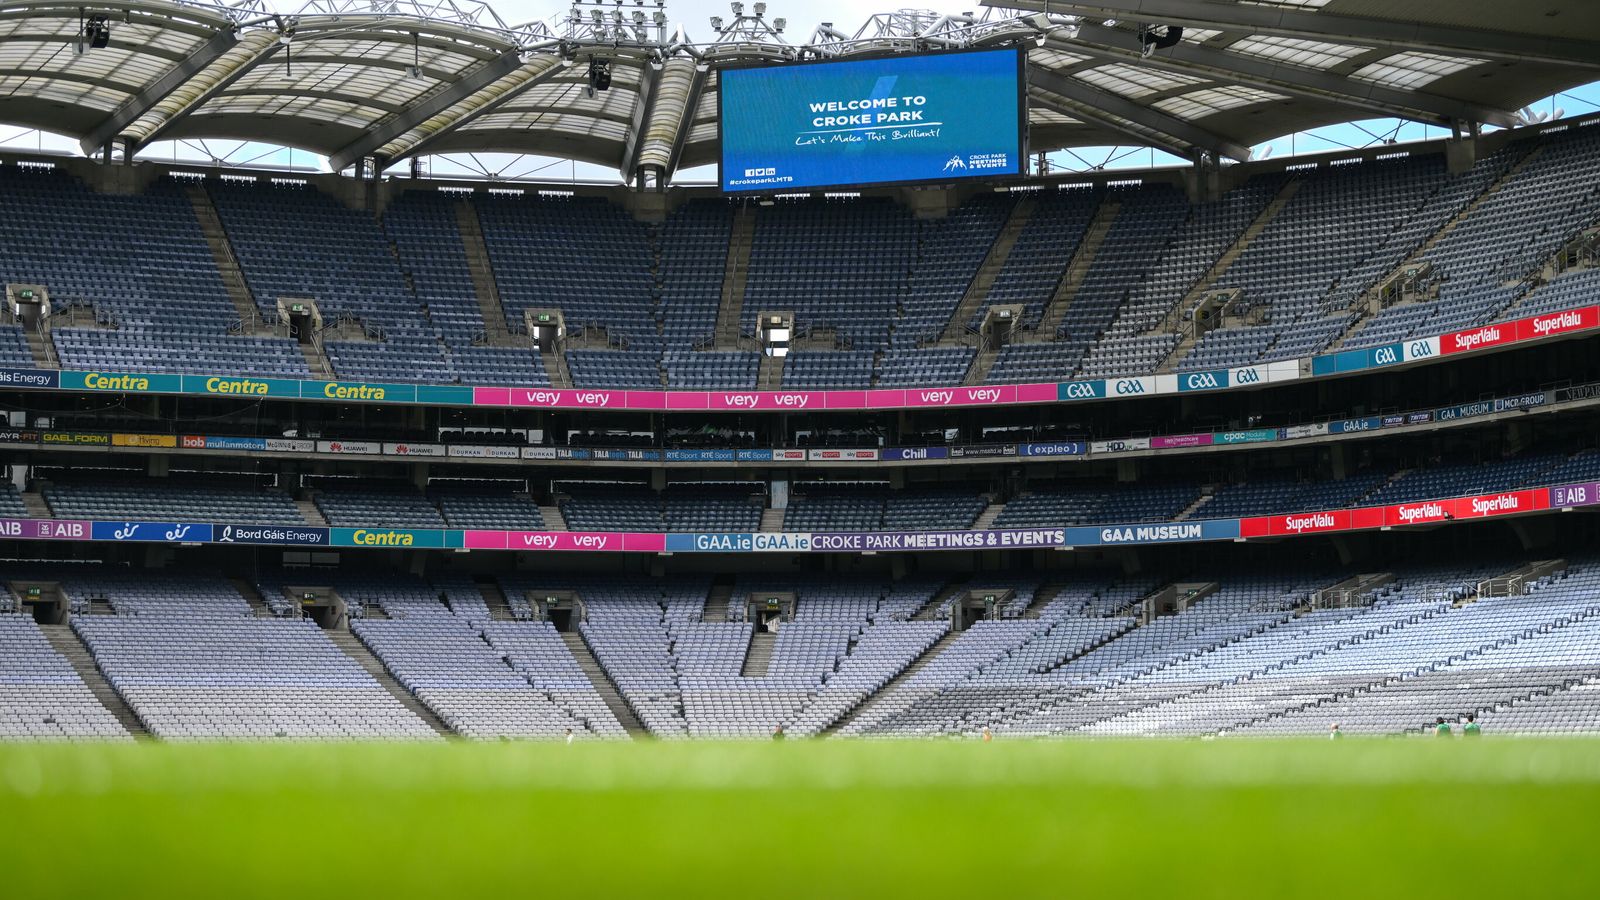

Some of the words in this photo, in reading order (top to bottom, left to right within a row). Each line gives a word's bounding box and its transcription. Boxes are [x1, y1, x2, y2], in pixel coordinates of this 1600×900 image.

[809, 98, 897, 113] WELCOME
[902, 95, 926, 106] TO
[812, 114, 872, 127] CROKE
[877, 110, 923, 123] PARK
[795, 135, 825, 145] Let's
[830, 134, 863, 143] Make
[865, 131, 886, 141] This
[891, 128, 940, 140] Brilliant!
[730, 176, 793, 185] #crokeparkLMTB
[1533, 311, 1581, 334] SuperValu
[1455, 328, 1500, 350] SuperValu
[1375, 347, 1397, 364] GAA
[1411, 342, 1432, 358] GAA
[13, 373, 51, 385] Energy
[84, 373, 149, 390] Centra
[1188, 373, 1217, 389] GAA
[1237, 368, 1259, 384] GAA
[206, 377, 269, 395] Centra
[324, 382, 385, 400] Centra
[1067, 383, 1095, 398] GAA
[1116, 379, 1144, 394] GAA
[526, 391, 561, 406] very
[576, 392, 609, 406] very
[724, 394, 759, 408] very
[774, 394, 808, 408] very
[921, 390, 953, 404] very
[968, 388, 1000, 402] very
[1441, 409, 1455, 420] GAA
[1460, 402, 1489, 416] MUSEUM
[1343, 420, 1368, 431] GAA.ie
[43, 433, 73, 442] GAEL
[75, 434, 108, 443] FORM
[183, 436, 205, 447] bob
[206, 440, 264, 450] mullanmotors
[1224, 432, 1245, 442] cpac
[680, 451, 697, 460] Sport
[715, 451, 732, 460] Sport
[752, 451, 770, 460] Sport
[902, 448, 927, 459] Chill
[1566, 487, 1586, 503] AIB
[1472, 494, 1518, 513] SuperValu
[1399, 505, 1442, 523] SuperValu
[54, 523, 83, 537] AIB
[114, 522, 139, 539] eir
[1285, 513, 1335, 533] SuperValu
[166, 523, 190, 540] eir
[236, 529, 261, 539] Bord
[262, 529, 285, 540] Gáis
[286, 530, 322, 543] Energy
[353, 529, 414, 546] Centra
[811, 535, 861, 549] CROKE
[866, 535, 901, 548] PARK
[904, 533, 984, 548] MEETINGS
[986, 532, 997, 546] &
[1001, 530, 1064, 545] EVENTS
[1101, 527, 1134, 542] GAA
[1136, 524, 1200, 541] MUSEUM
[523, 534, 557, 548] very
[573, 535, 607, 549] very
[697, 534, 750, 550] GAA.ie
[755, 534, 809, 549] GAA.ie
